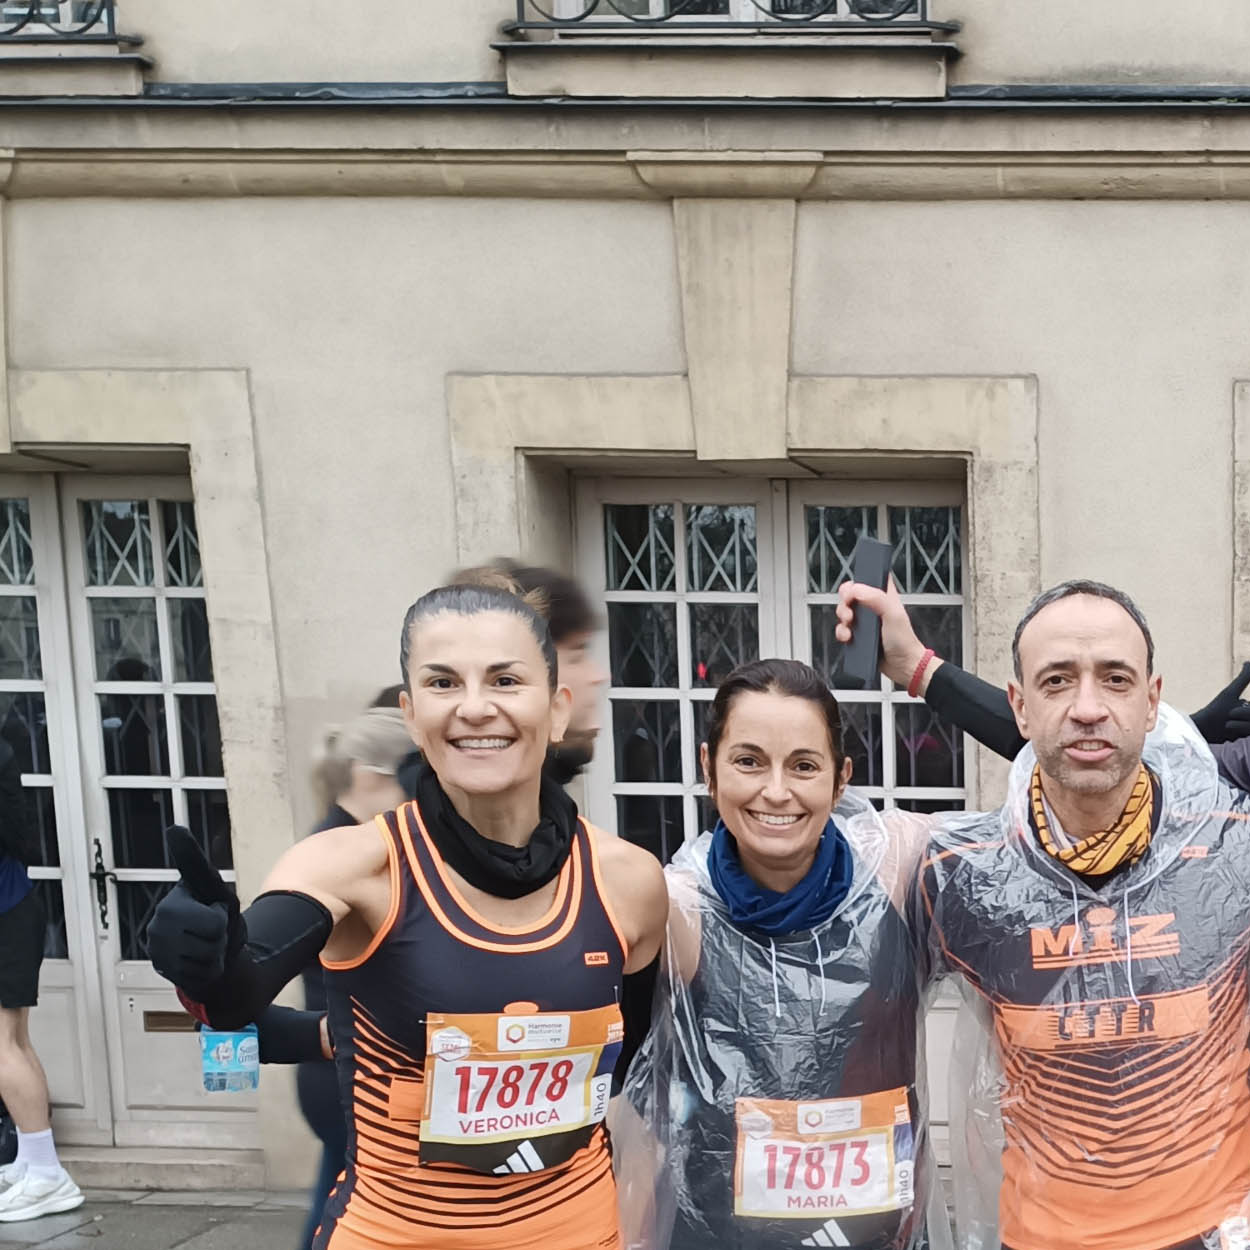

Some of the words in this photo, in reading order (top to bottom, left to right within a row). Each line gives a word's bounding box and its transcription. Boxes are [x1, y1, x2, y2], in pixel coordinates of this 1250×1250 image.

[1030, 907, 1181, 957] MiZ
[455, 1060, 574, 1114] 17878
[459, 1108, 560, 1134] VERONICA
[764, 1141, 870, 1190] 17873
[787, 1195, 848, 1209] MARIA
